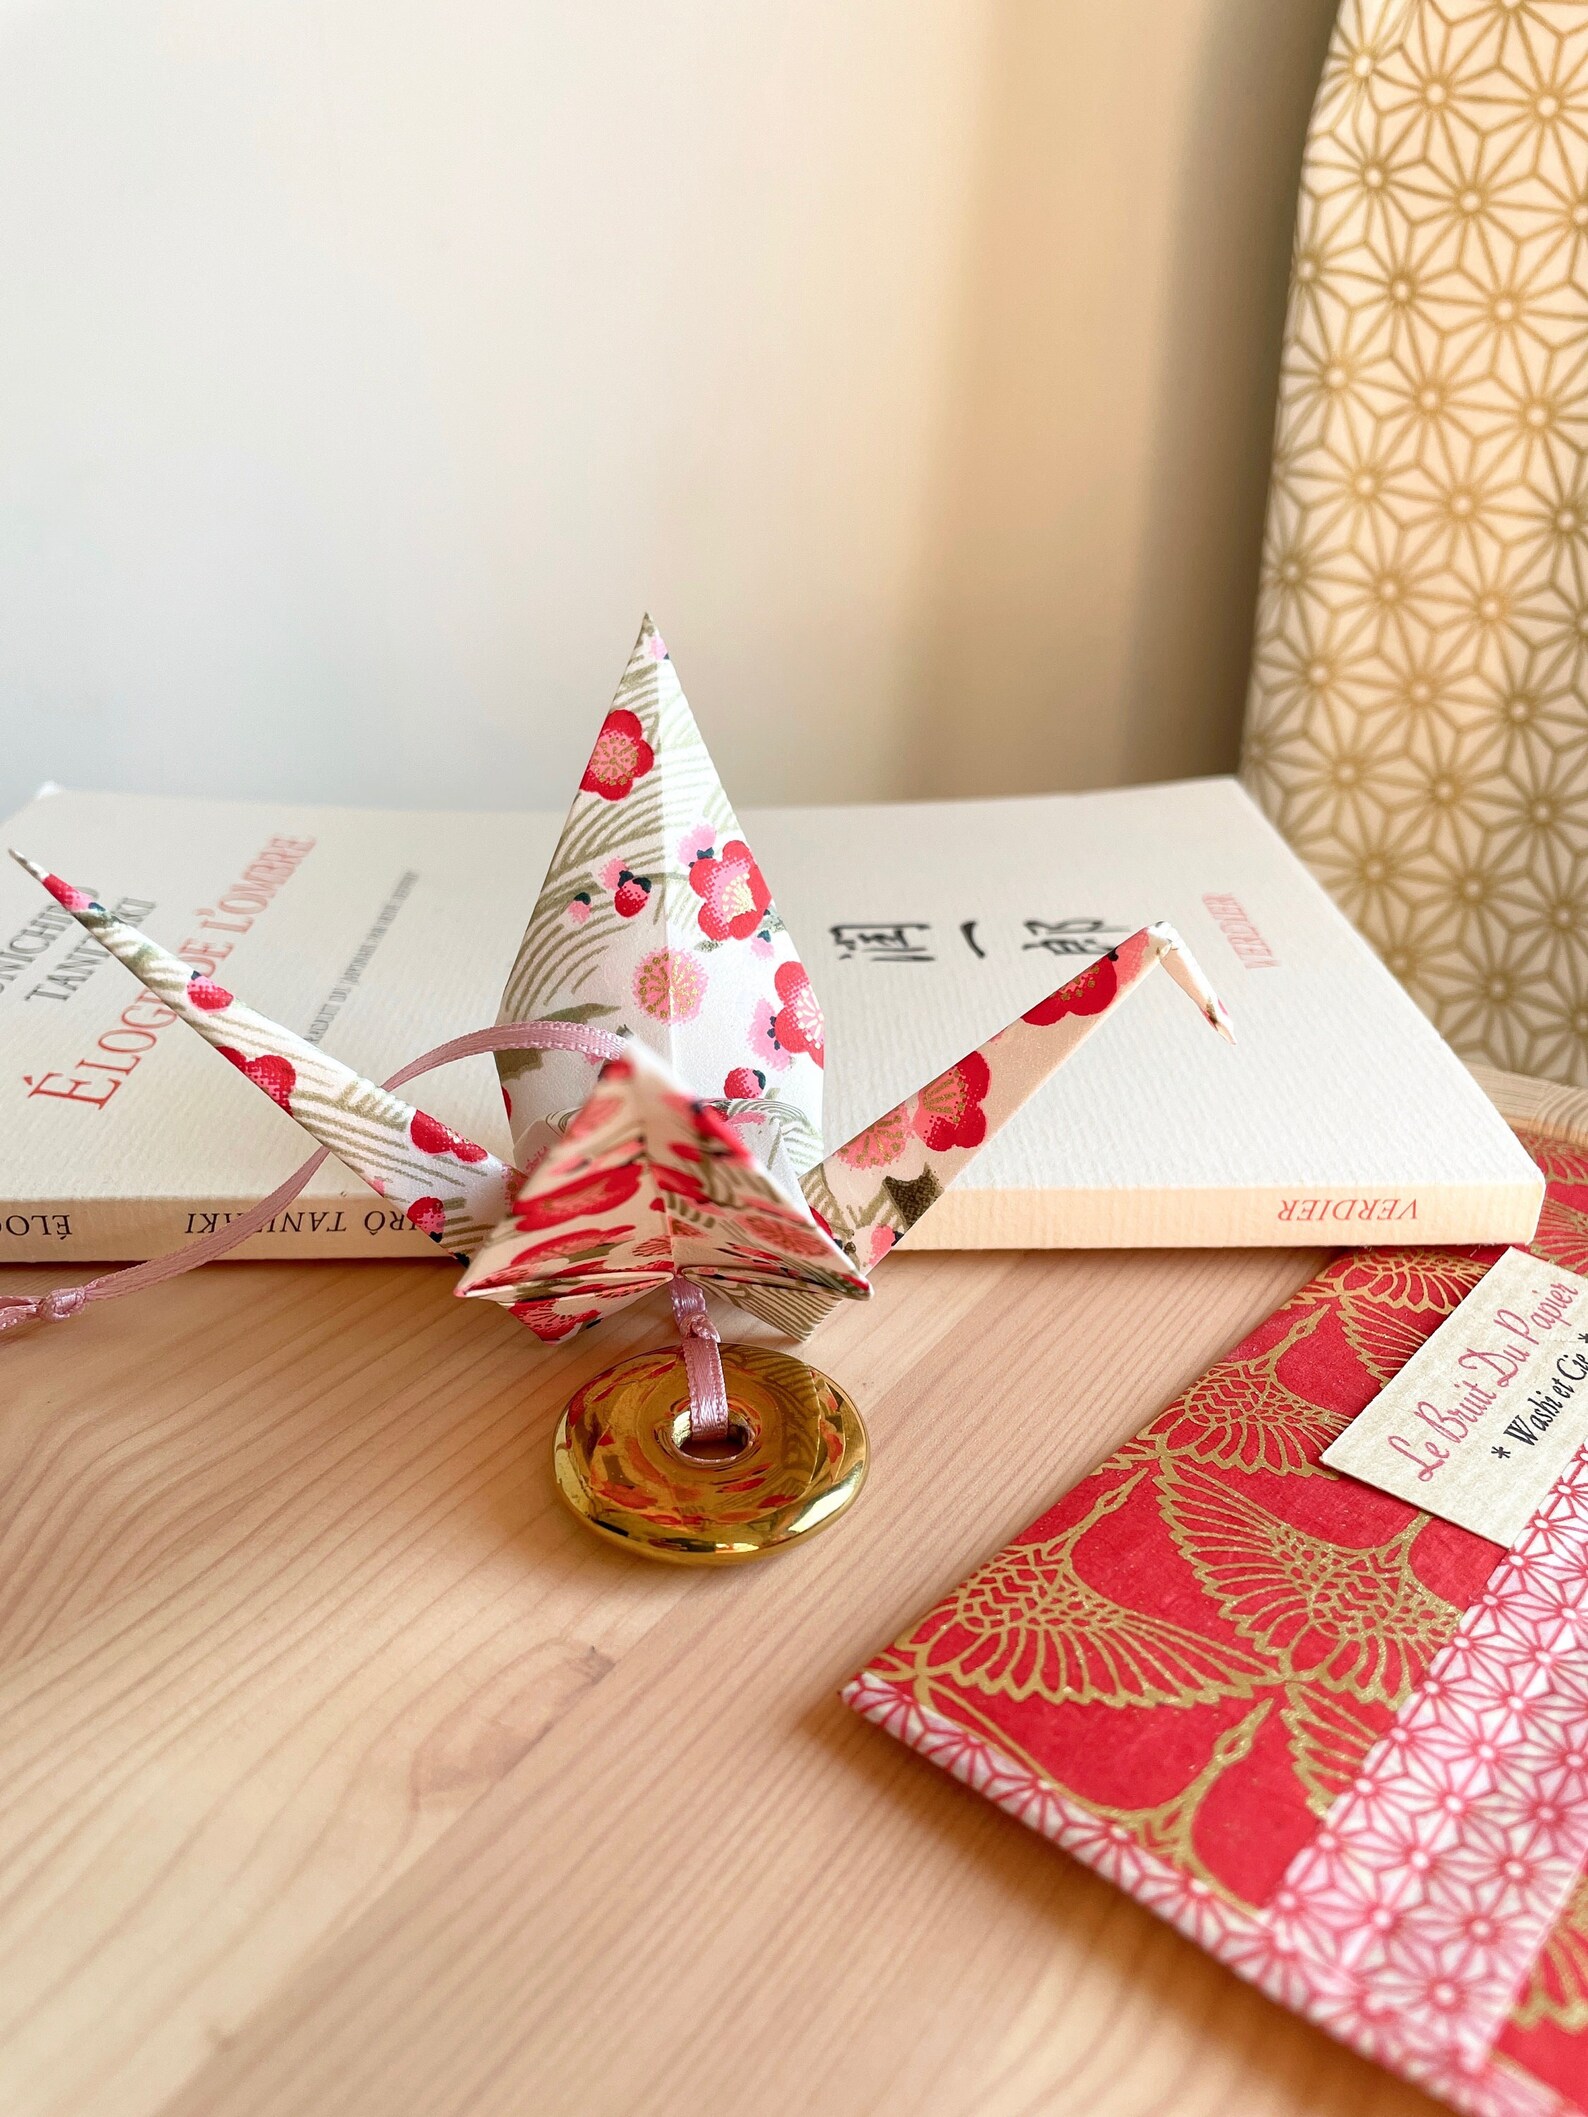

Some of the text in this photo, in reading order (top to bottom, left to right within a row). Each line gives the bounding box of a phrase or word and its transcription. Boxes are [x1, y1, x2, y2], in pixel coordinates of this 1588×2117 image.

[24, 897, 157, 1001] TANIKI
[0, 1214, 73, 1241] ÉLO
[184, 1210, 347, 1234] TANIKI
[1277, 1198, 1418, 1222] VERDIER
[1388, 1282, 1579, 1482] Le Bruit Du Papier
[1503, 1353, 1588, 1447] Washi et Cie
